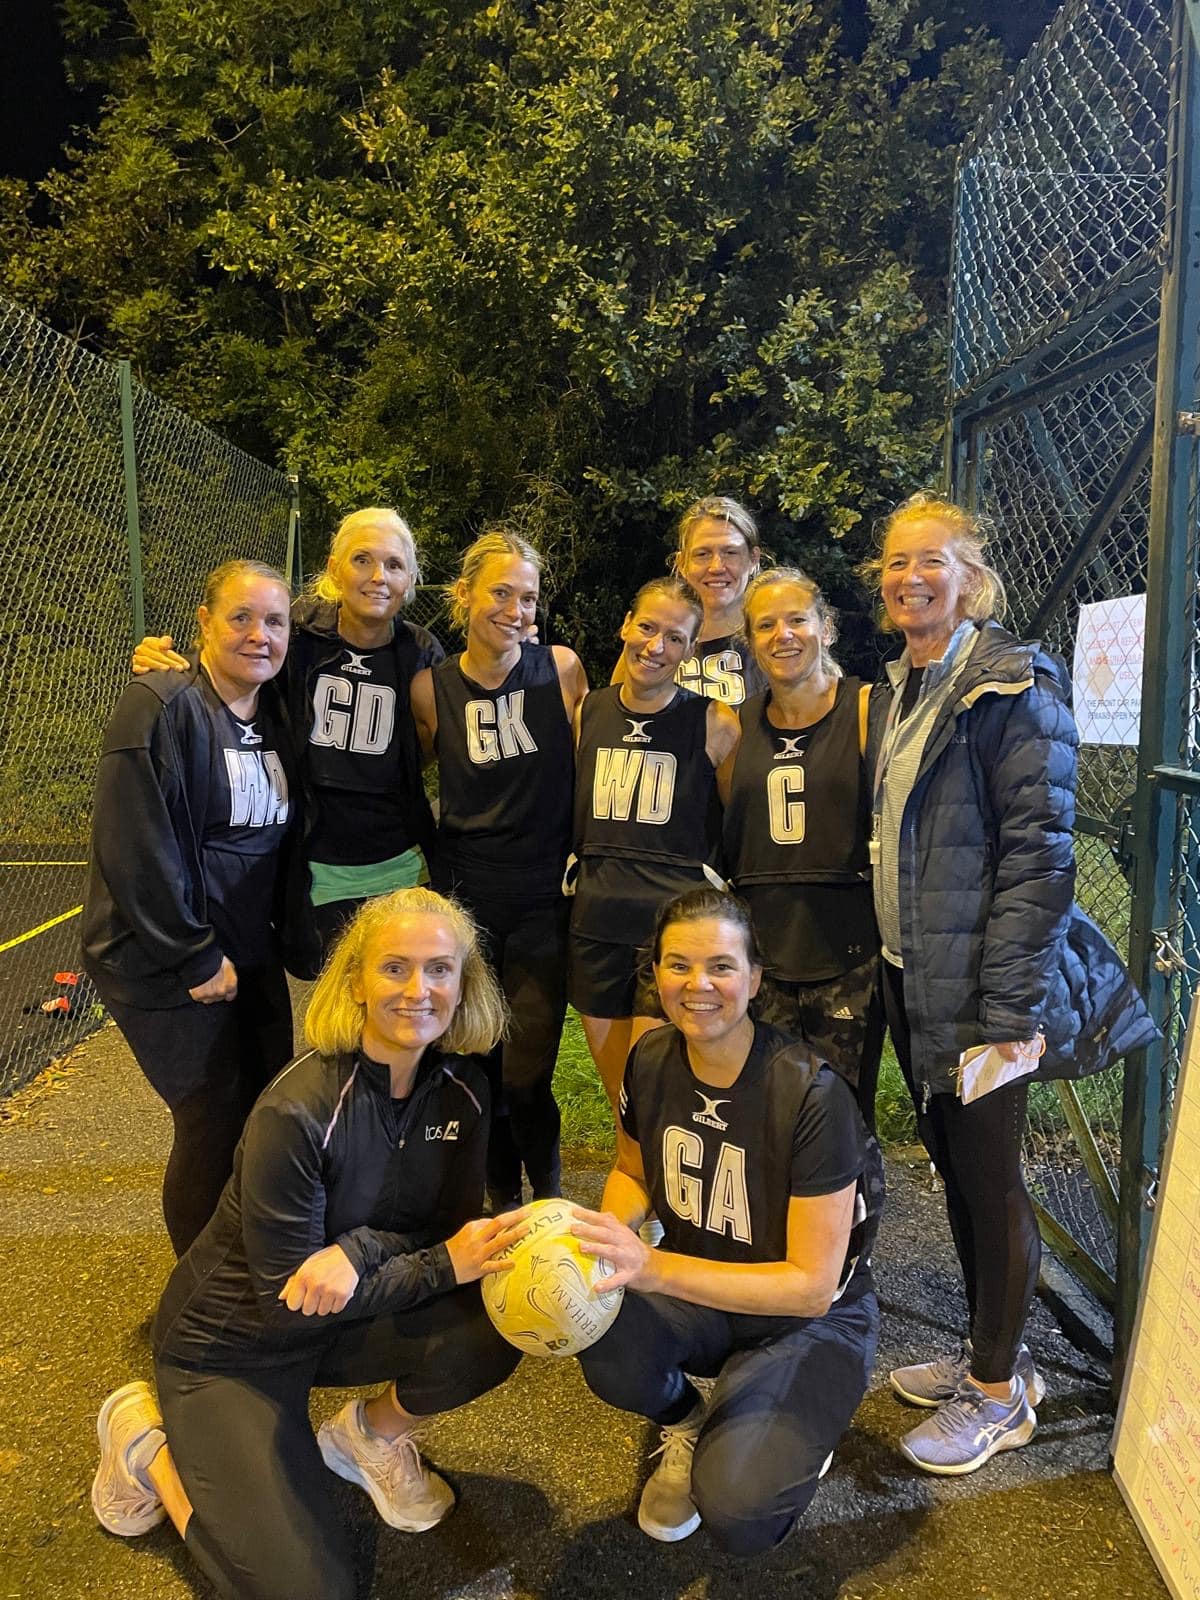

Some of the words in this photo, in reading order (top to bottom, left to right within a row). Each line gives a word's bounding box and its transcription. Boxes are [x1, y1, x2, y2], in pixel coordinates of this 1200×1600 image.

[341, 665, 372, 676] GILBERT
[674, 650, 745, 706] GS
[309, 673, 396, 755] GD
[465, 689, 538, 764] GK
[223, 747, 289, 828] WA
[593, 747, 677, 825] WD
[767, 765, 805, 845] C
[692, 1112, 729, 1131] GILBERT
[662, 1125, 752, 1245] GA
